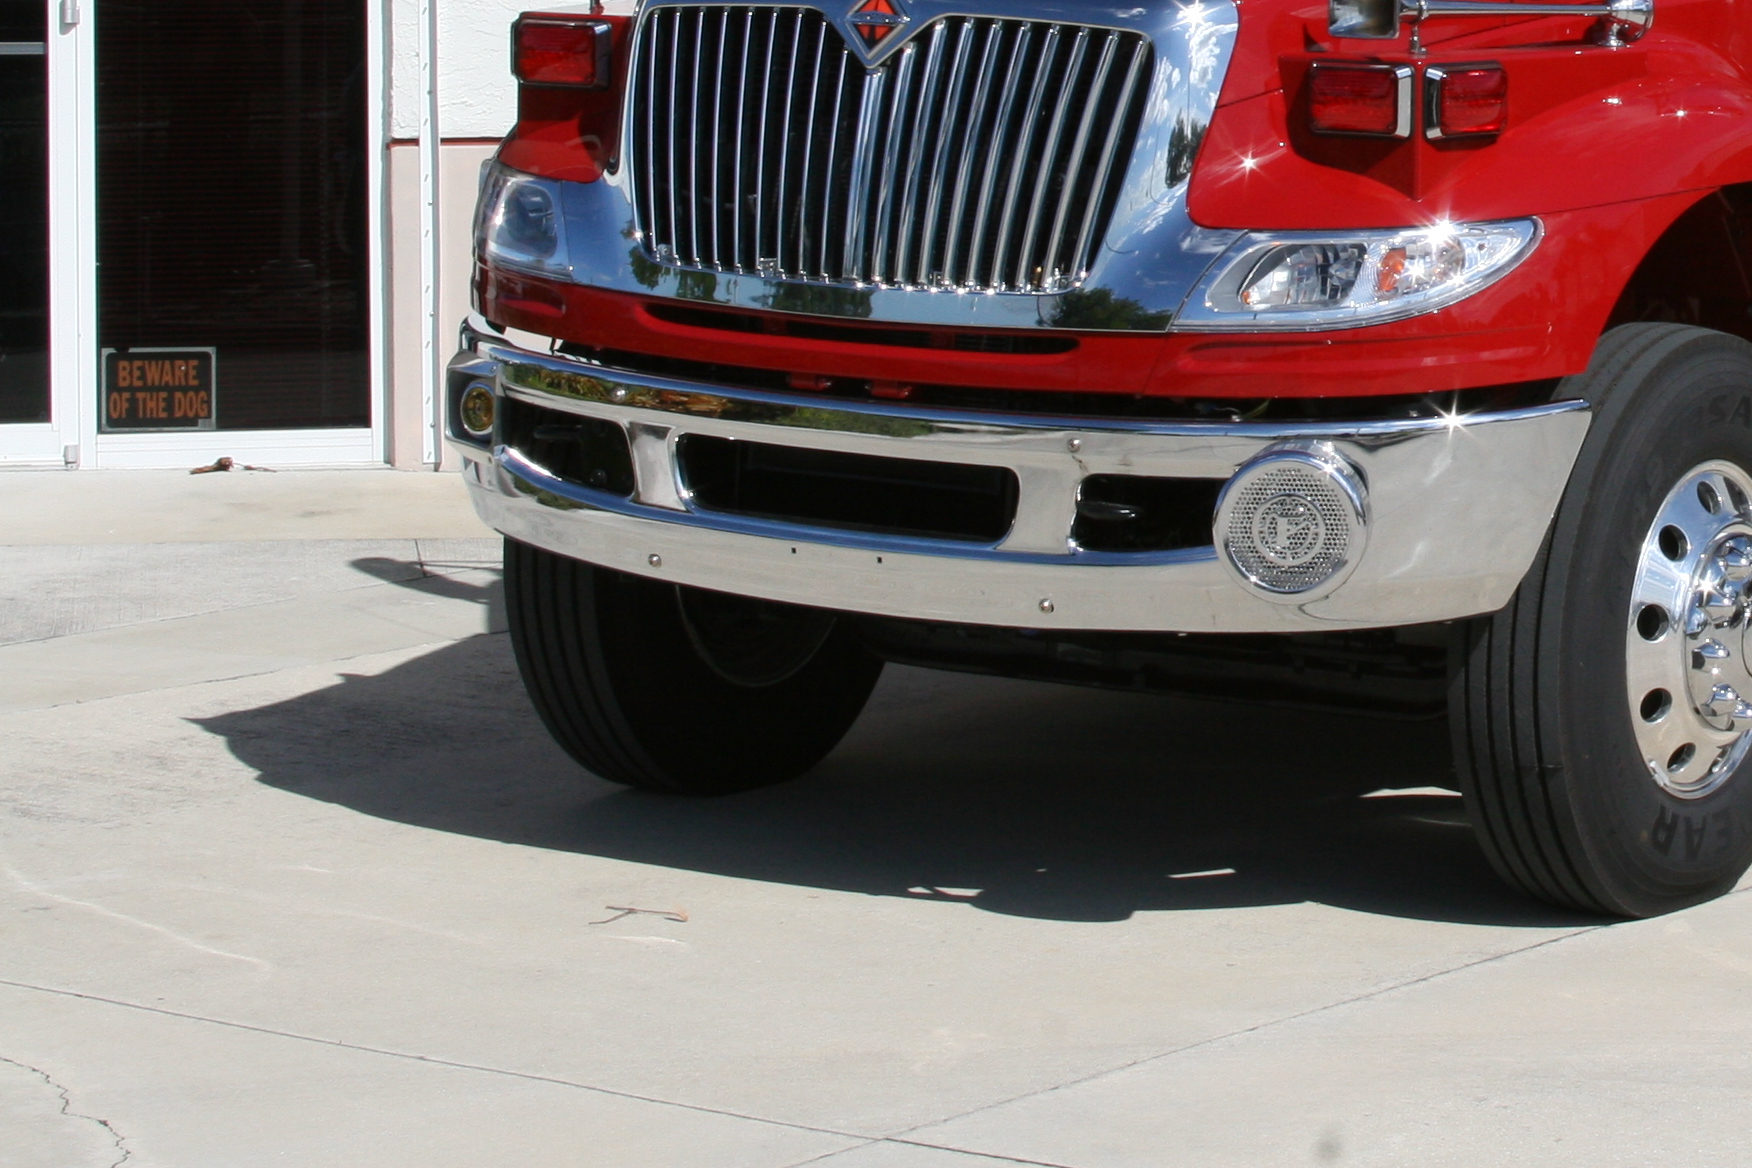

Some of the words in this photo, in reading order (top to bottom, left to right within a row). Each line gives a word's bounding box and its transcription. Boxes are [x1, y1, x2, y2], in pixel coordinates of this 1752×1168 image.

[117, 359, 199, 387] BEWARE
[109, 391, 131, 419] OF
[135, 391, 168, 419] THE
[173, 390, 208, 418] DOG
